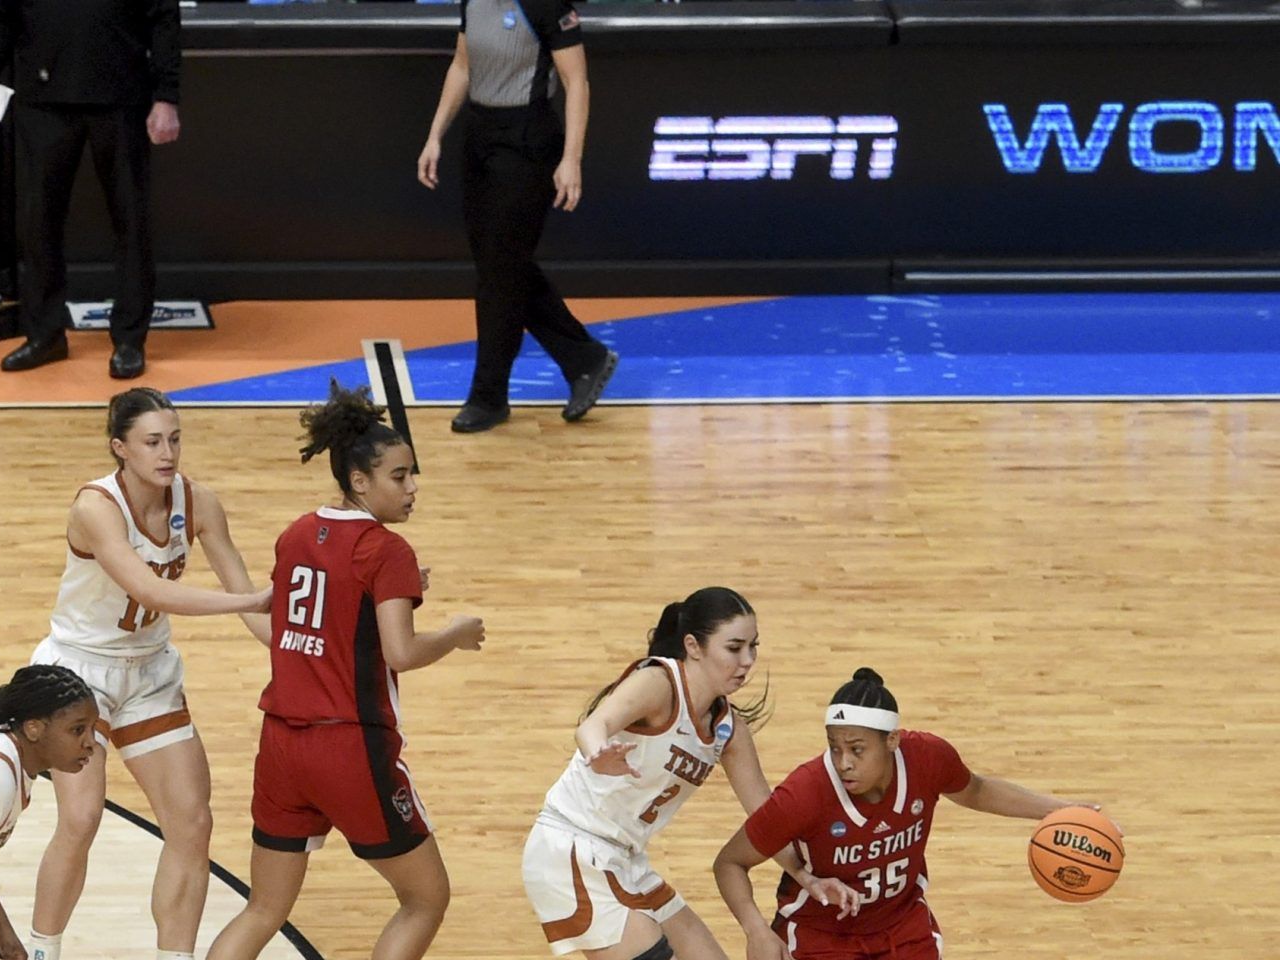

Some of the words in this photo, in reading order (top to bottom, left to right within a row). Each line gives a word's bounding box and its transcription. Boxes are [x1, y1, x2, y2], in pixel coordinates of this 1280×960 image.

[649, 115, 899, 180] ESPN
[287, 564, 327, 630] 21
[638, 783, 681, 825] 2
[833, 844, 864, 865] NC
[867, 818, 924, 861] STATE
[1052, 829, 1113, 863] Wilson
[857, 857, 910, 905] 35
